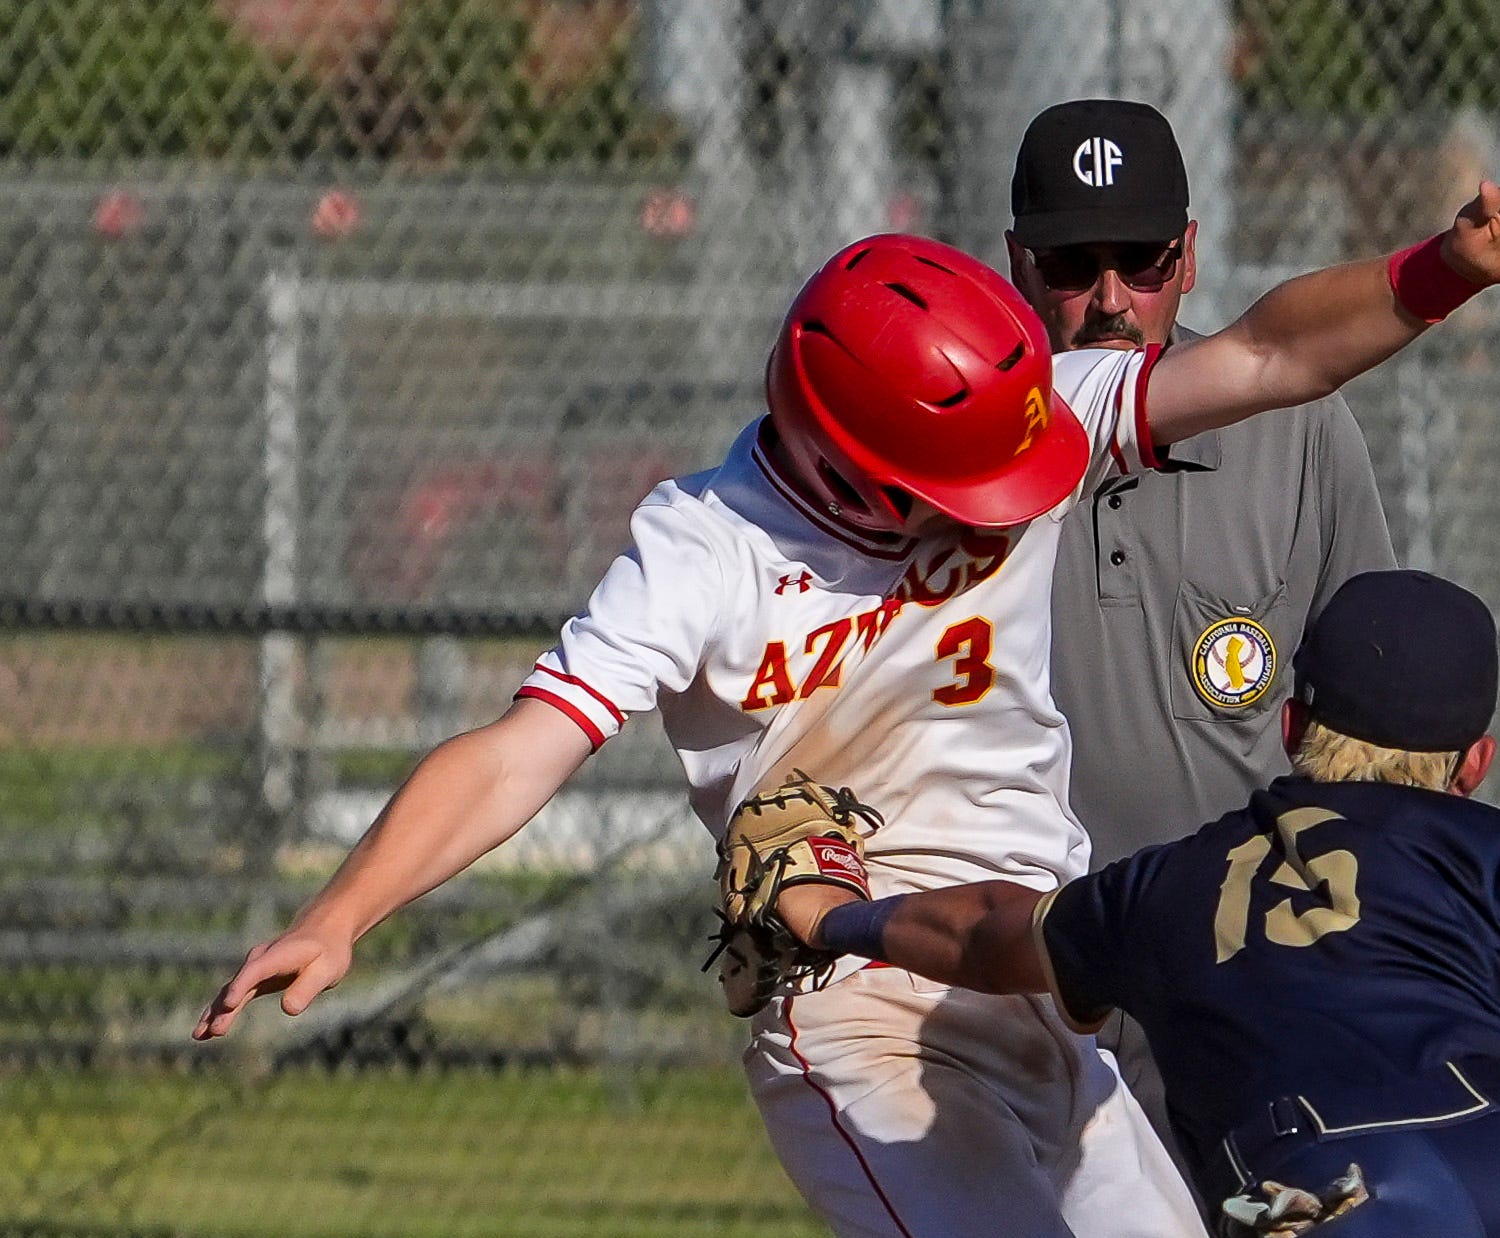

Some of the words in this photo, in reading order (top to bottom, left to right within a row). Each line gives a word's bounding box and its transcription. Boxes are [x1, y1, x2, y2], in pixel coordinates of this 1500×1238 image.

[1072, 136, 1123, 187] CIF
[740, 525, 1010, 713] AZTCS
[931, 615, 996, 707] 3
[1214, 806, 1362, 965] 15
